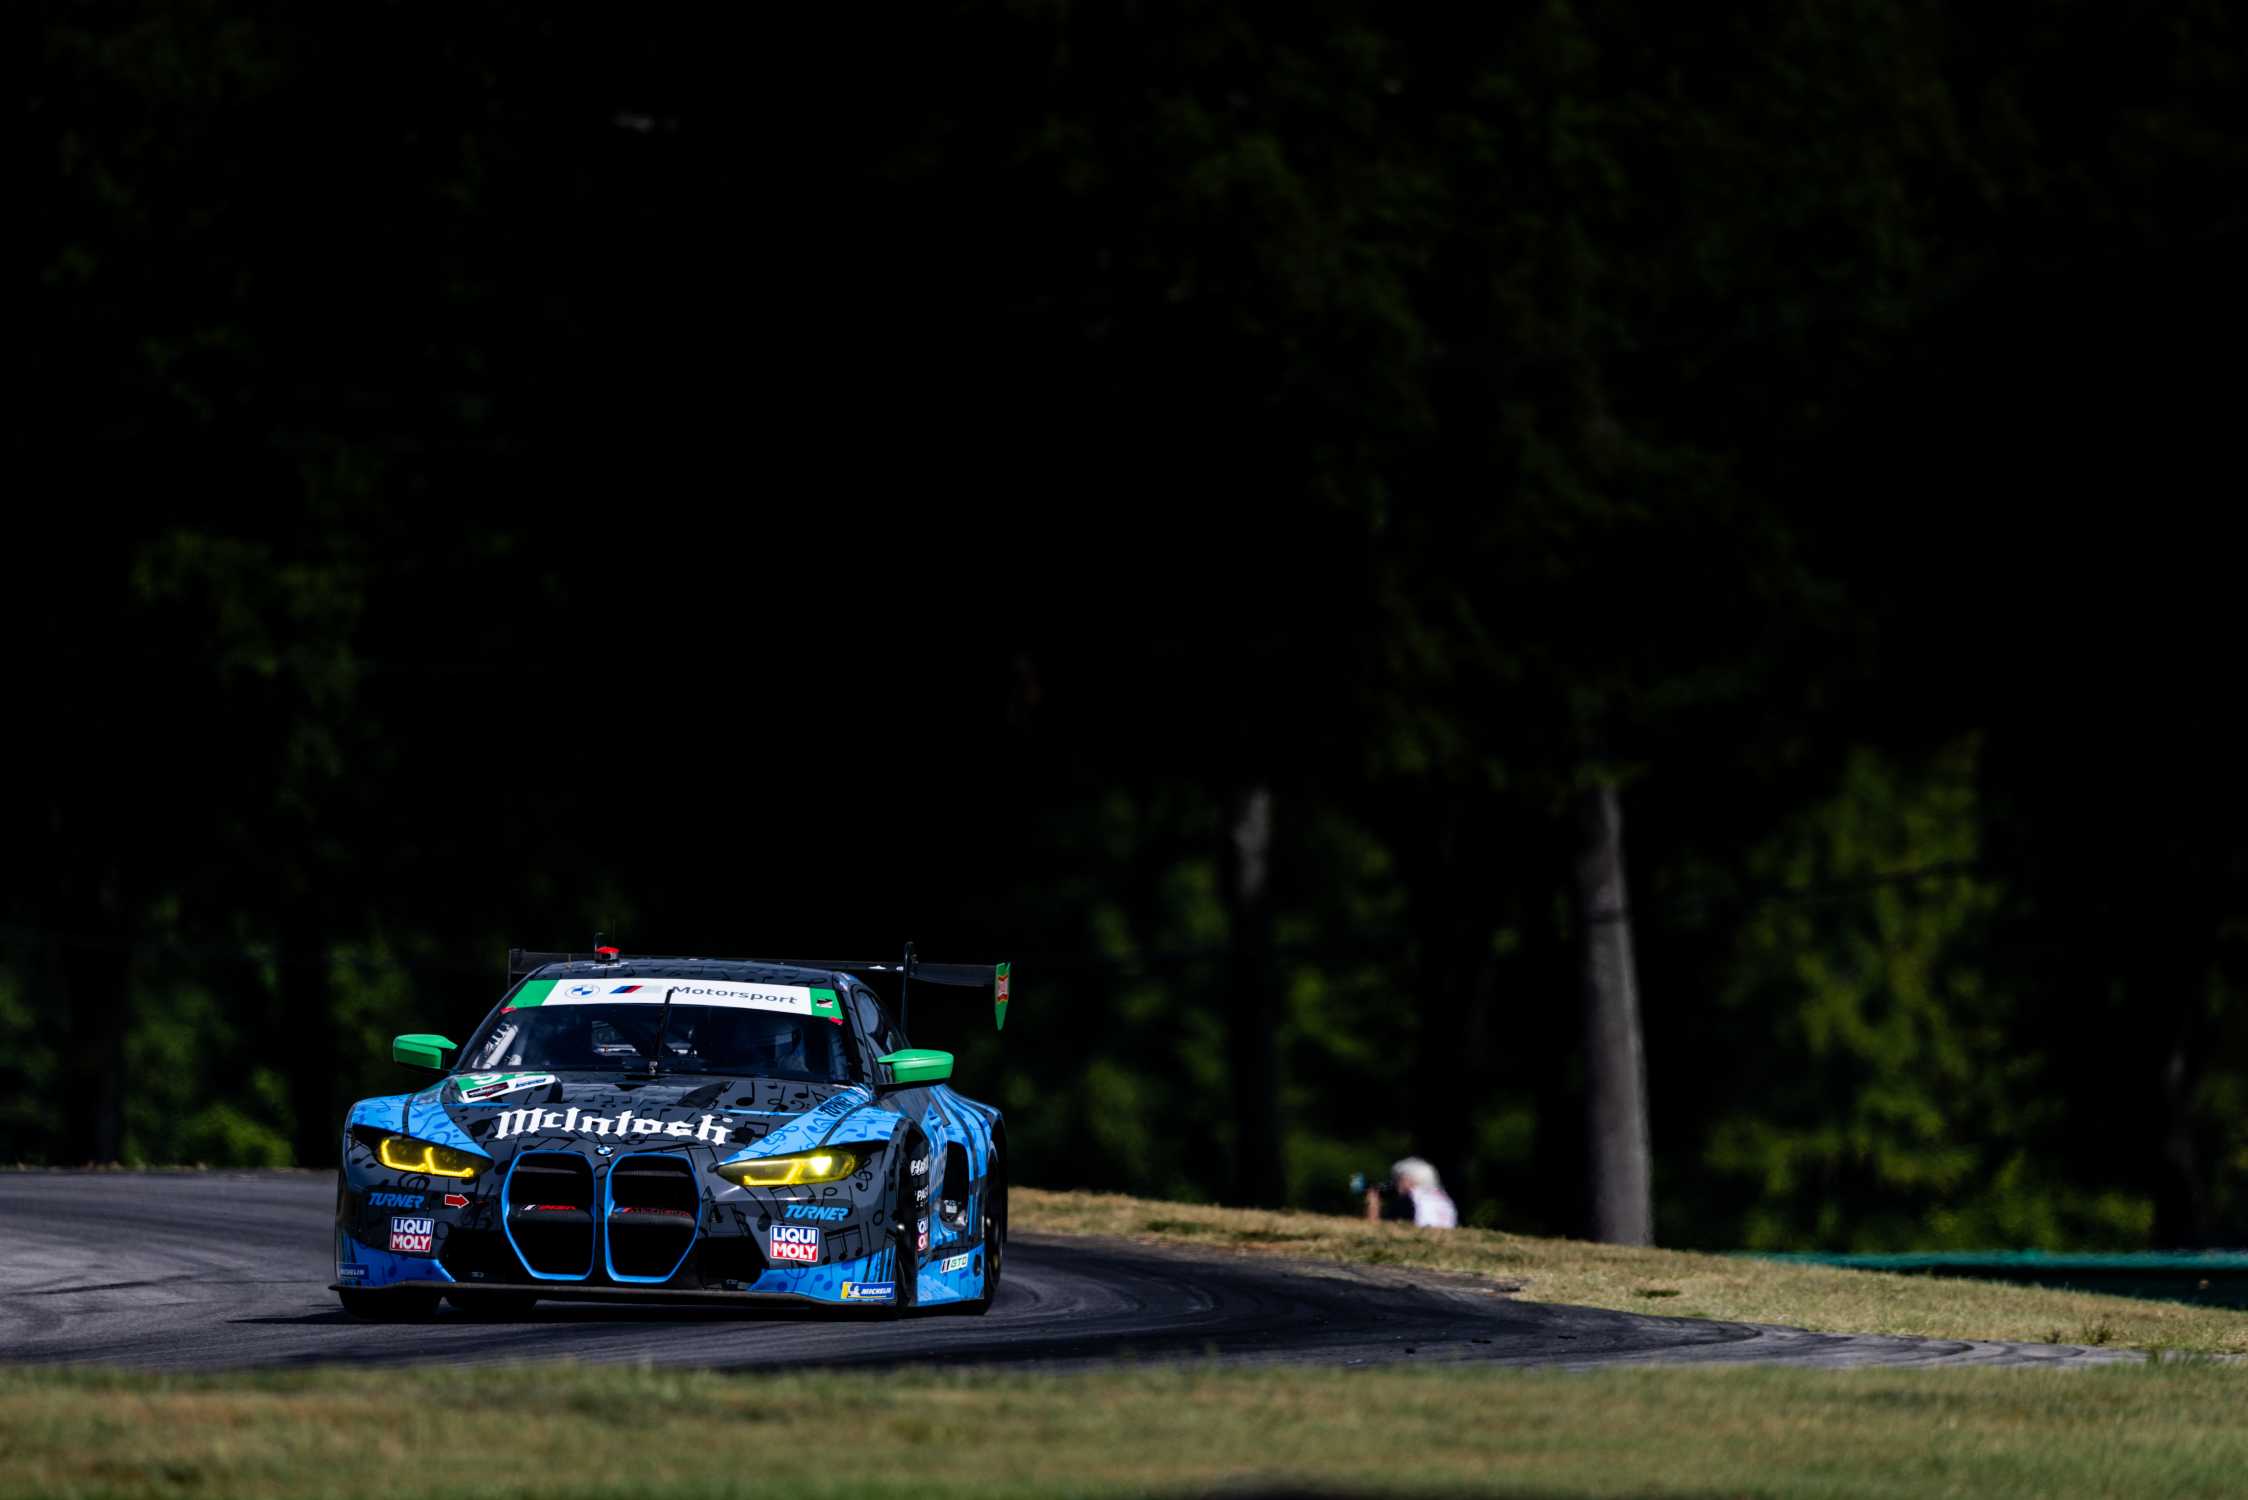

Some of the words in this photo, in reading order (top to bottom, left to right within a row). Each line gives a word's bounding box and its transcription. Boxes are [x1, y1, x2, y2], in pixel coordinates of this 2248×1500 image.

[671, 985, 798, 1005] Motorsport
[495, 1107, 732, 1146] McIntosh
[368, 1192, 425, 1209] TURNER
[785, 1204, 849, 1222] TURNER
[393, 1218, 432, 1235] LIQUI
[391, 1234, 431, 1250] MOLY
[773, 1227, 816, 1244] LIQUI
[773, 1242, 817, 1260] MOLY
